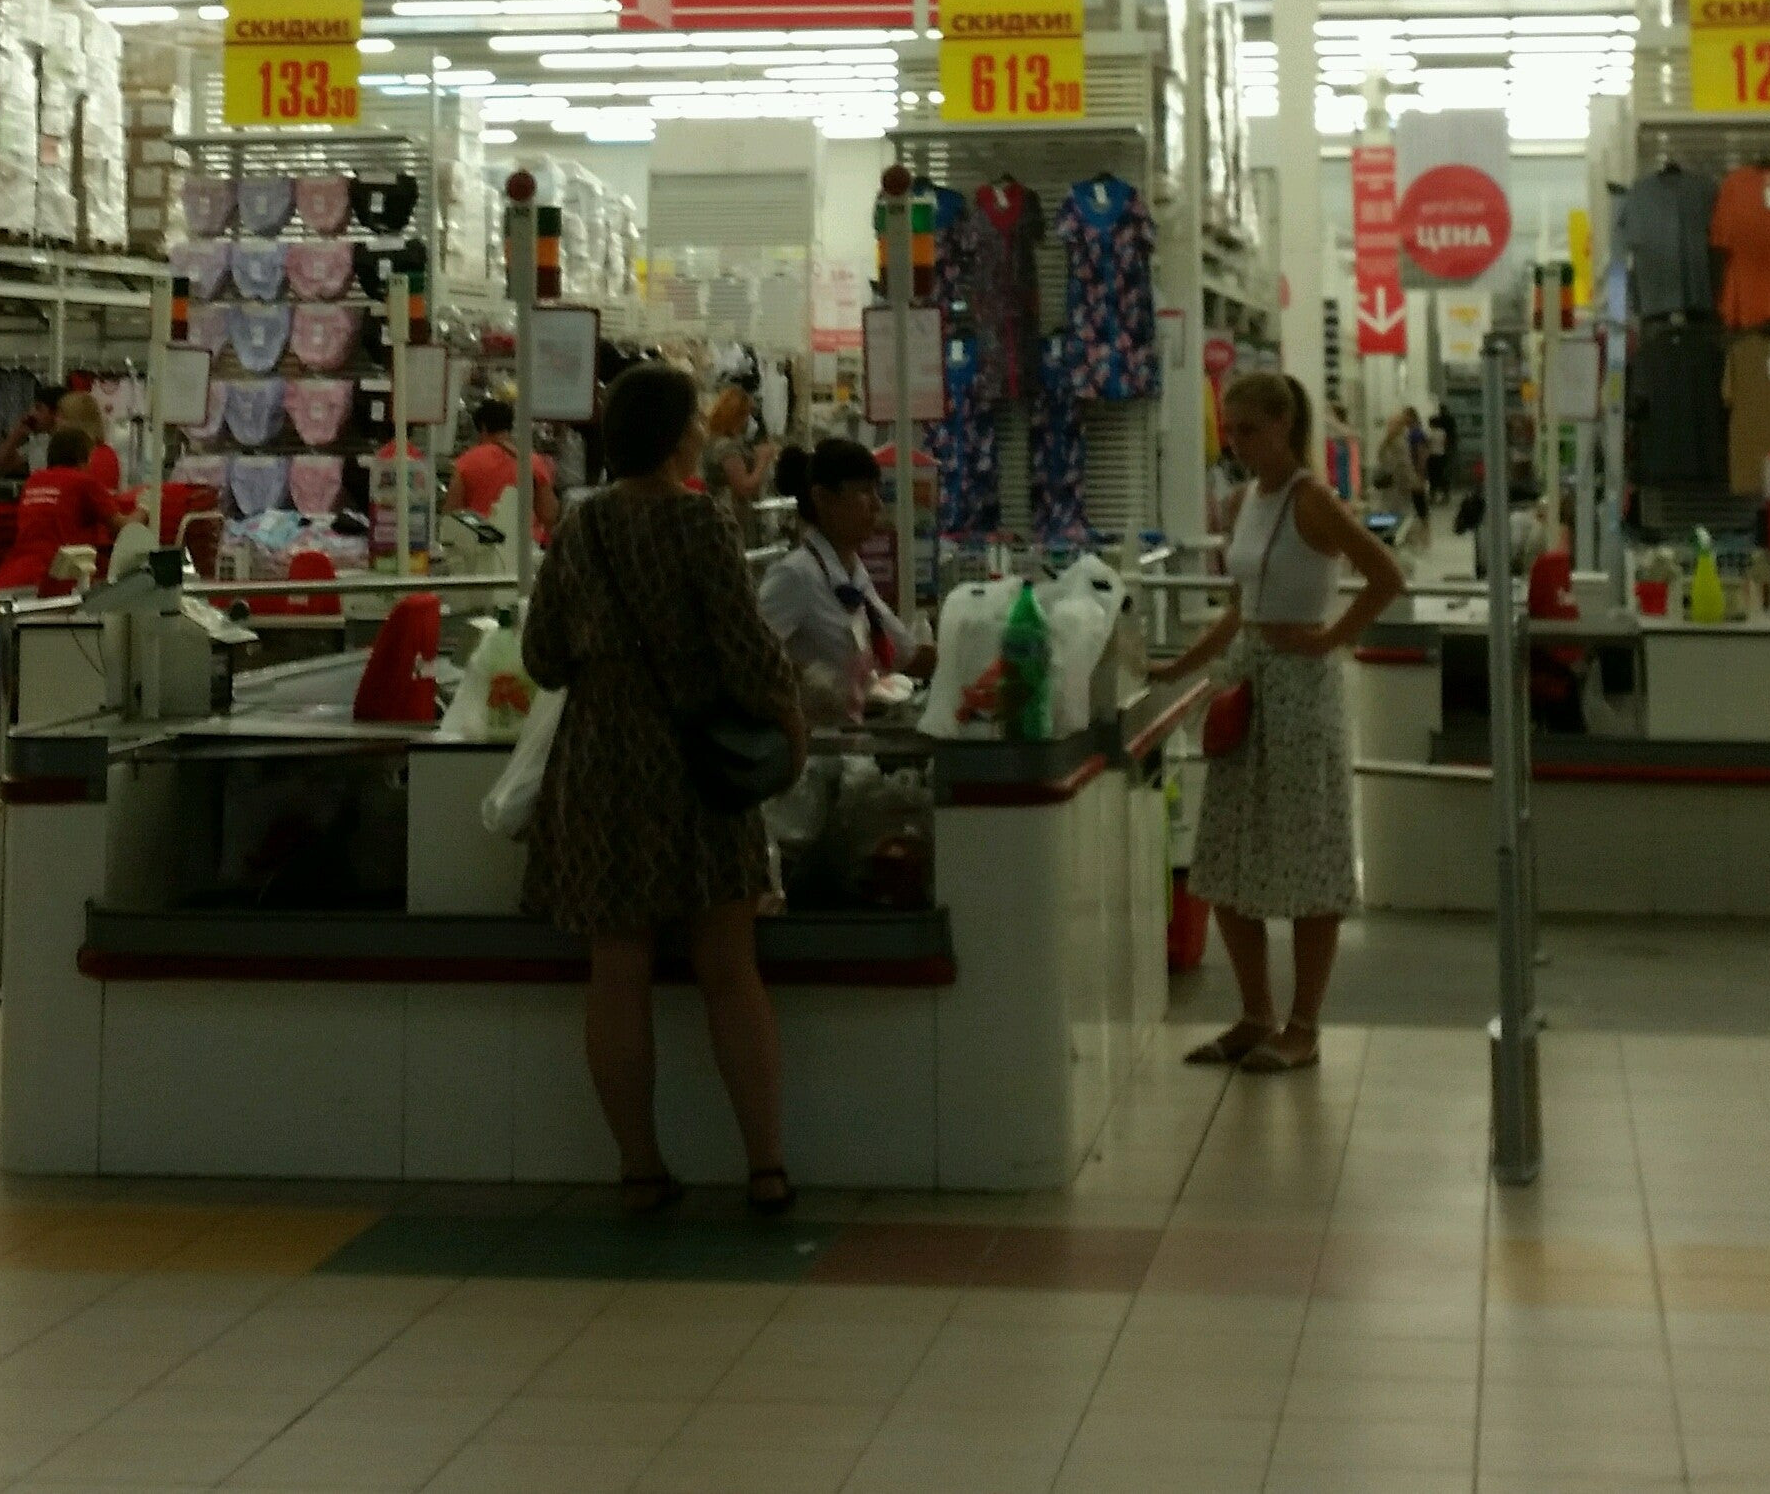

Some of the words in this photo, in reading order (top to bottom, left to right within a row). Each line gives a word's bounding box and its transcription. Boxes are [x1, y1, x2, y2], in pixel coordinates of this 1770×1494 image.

[234, 19, 350, 39] СКИДКИ!
[950, 12, 1073, 33] СКИДКИ!
[259, 60, 329, 118] 133
[971, 53, 1050, 114] 613
[1416, 224, 1493, 254] ЦЕНА
